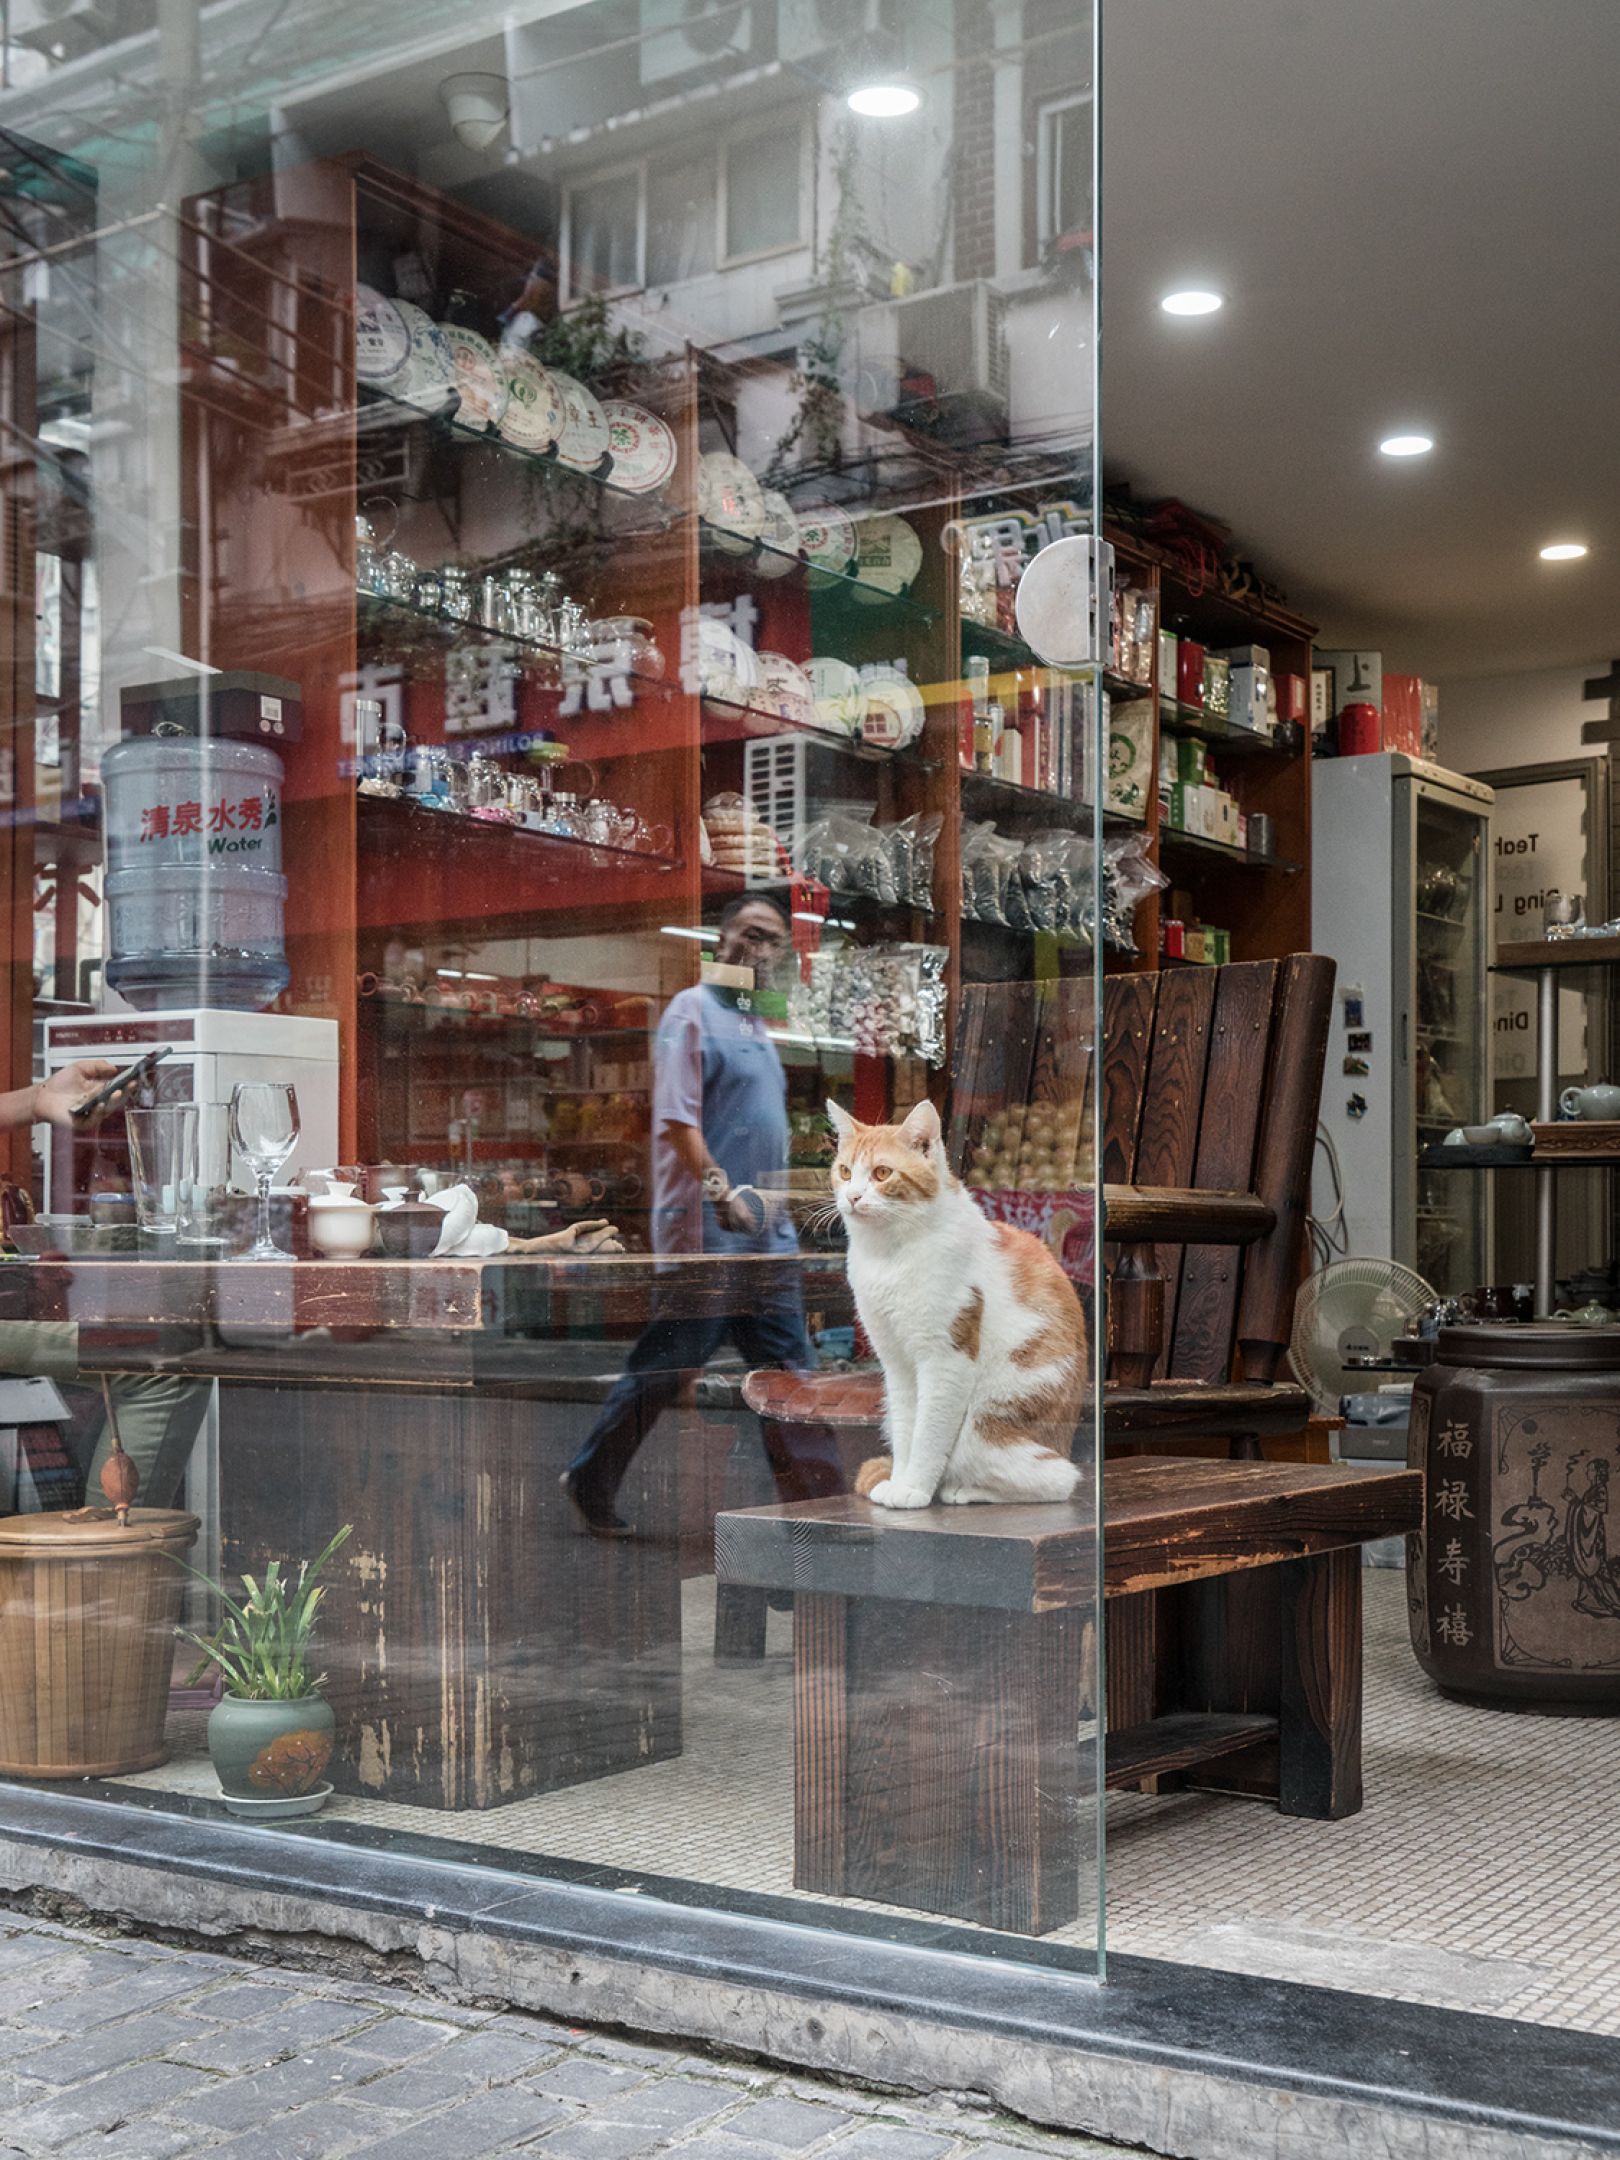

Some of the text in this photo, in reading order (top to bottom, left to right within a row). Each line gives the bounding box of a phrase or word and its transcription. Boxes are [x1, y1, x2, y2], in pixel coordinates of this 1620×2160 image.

[139, 797, 264, 843] 清泉水秀
[208, 837, 263, 855] Water
[1434, 1419, 1476, 1648] 福禄寿禧
